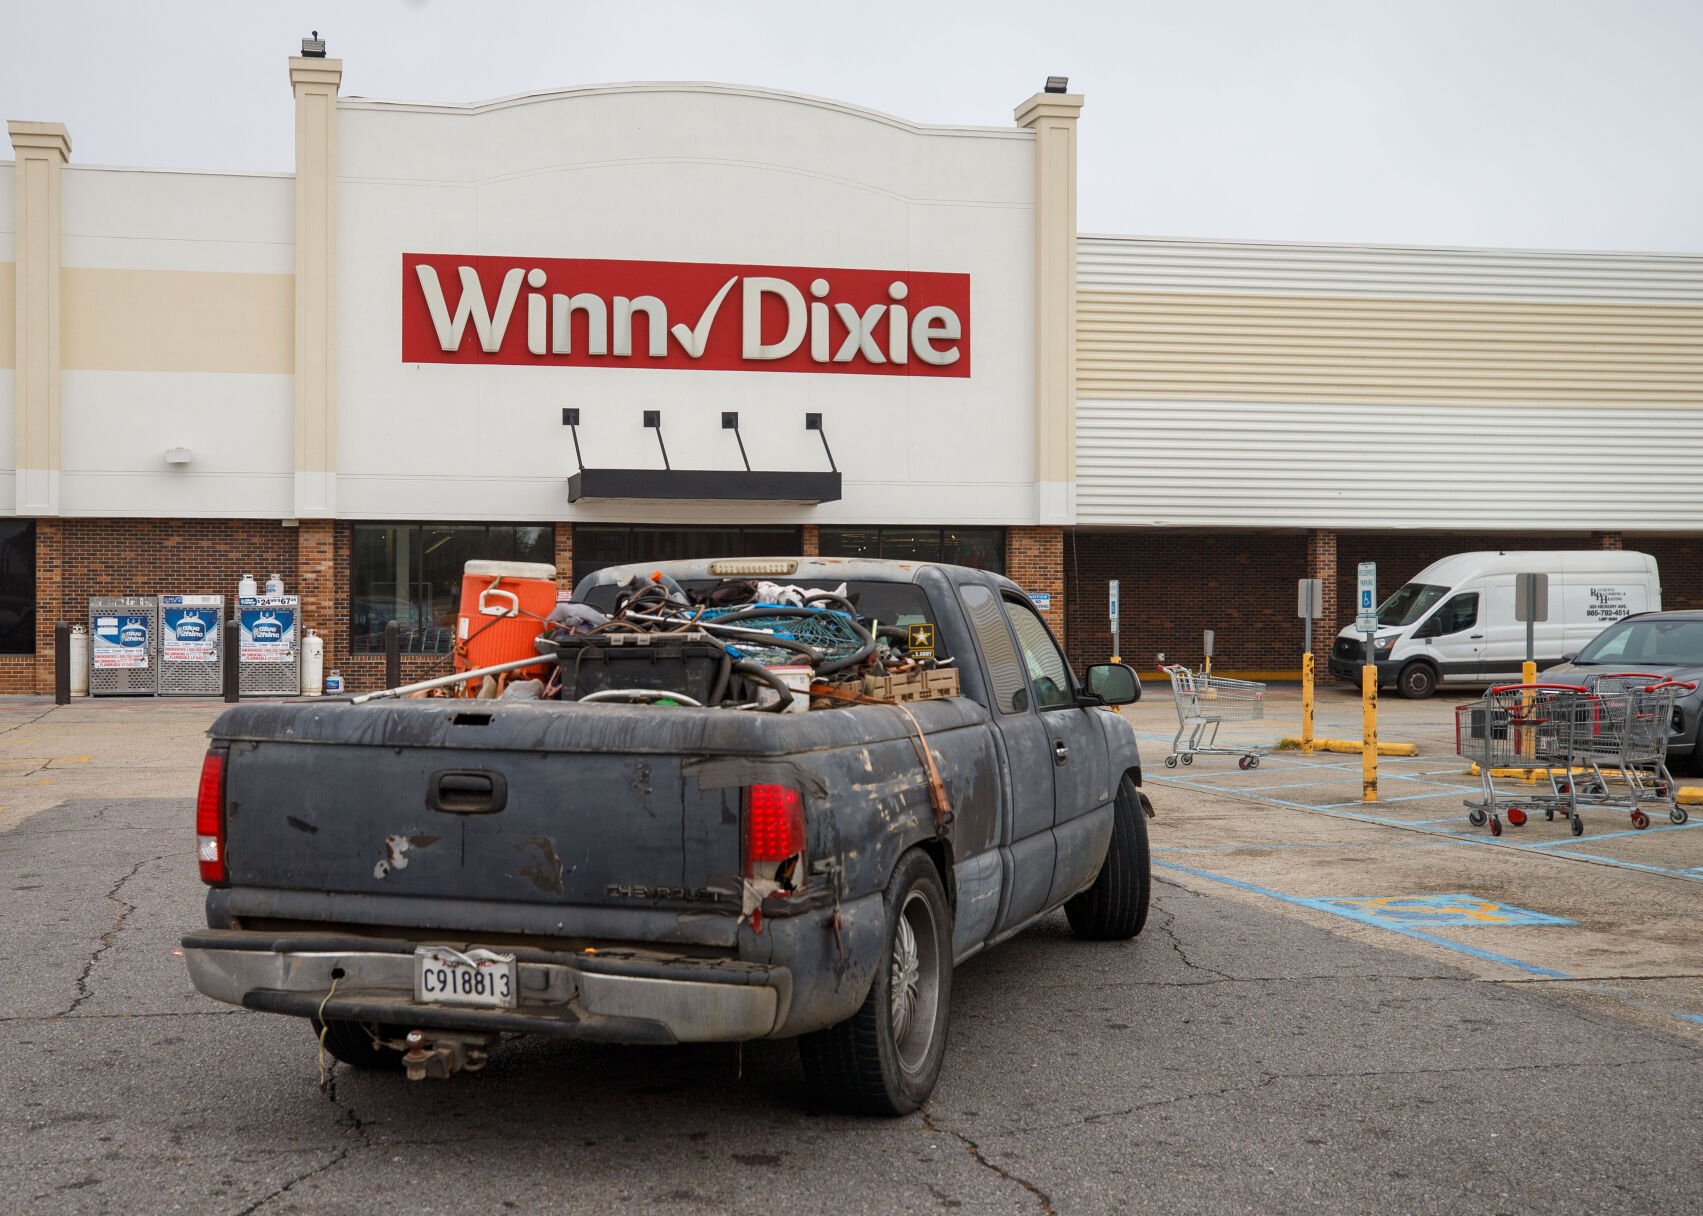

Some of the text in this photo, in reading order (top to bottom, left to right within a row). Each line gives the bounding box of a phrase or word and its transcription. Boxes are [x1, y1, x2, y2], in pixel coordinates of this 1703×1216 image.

[415, 264, 962, 365] Winn Dixie
[424, 968, 511, 998] C918813
